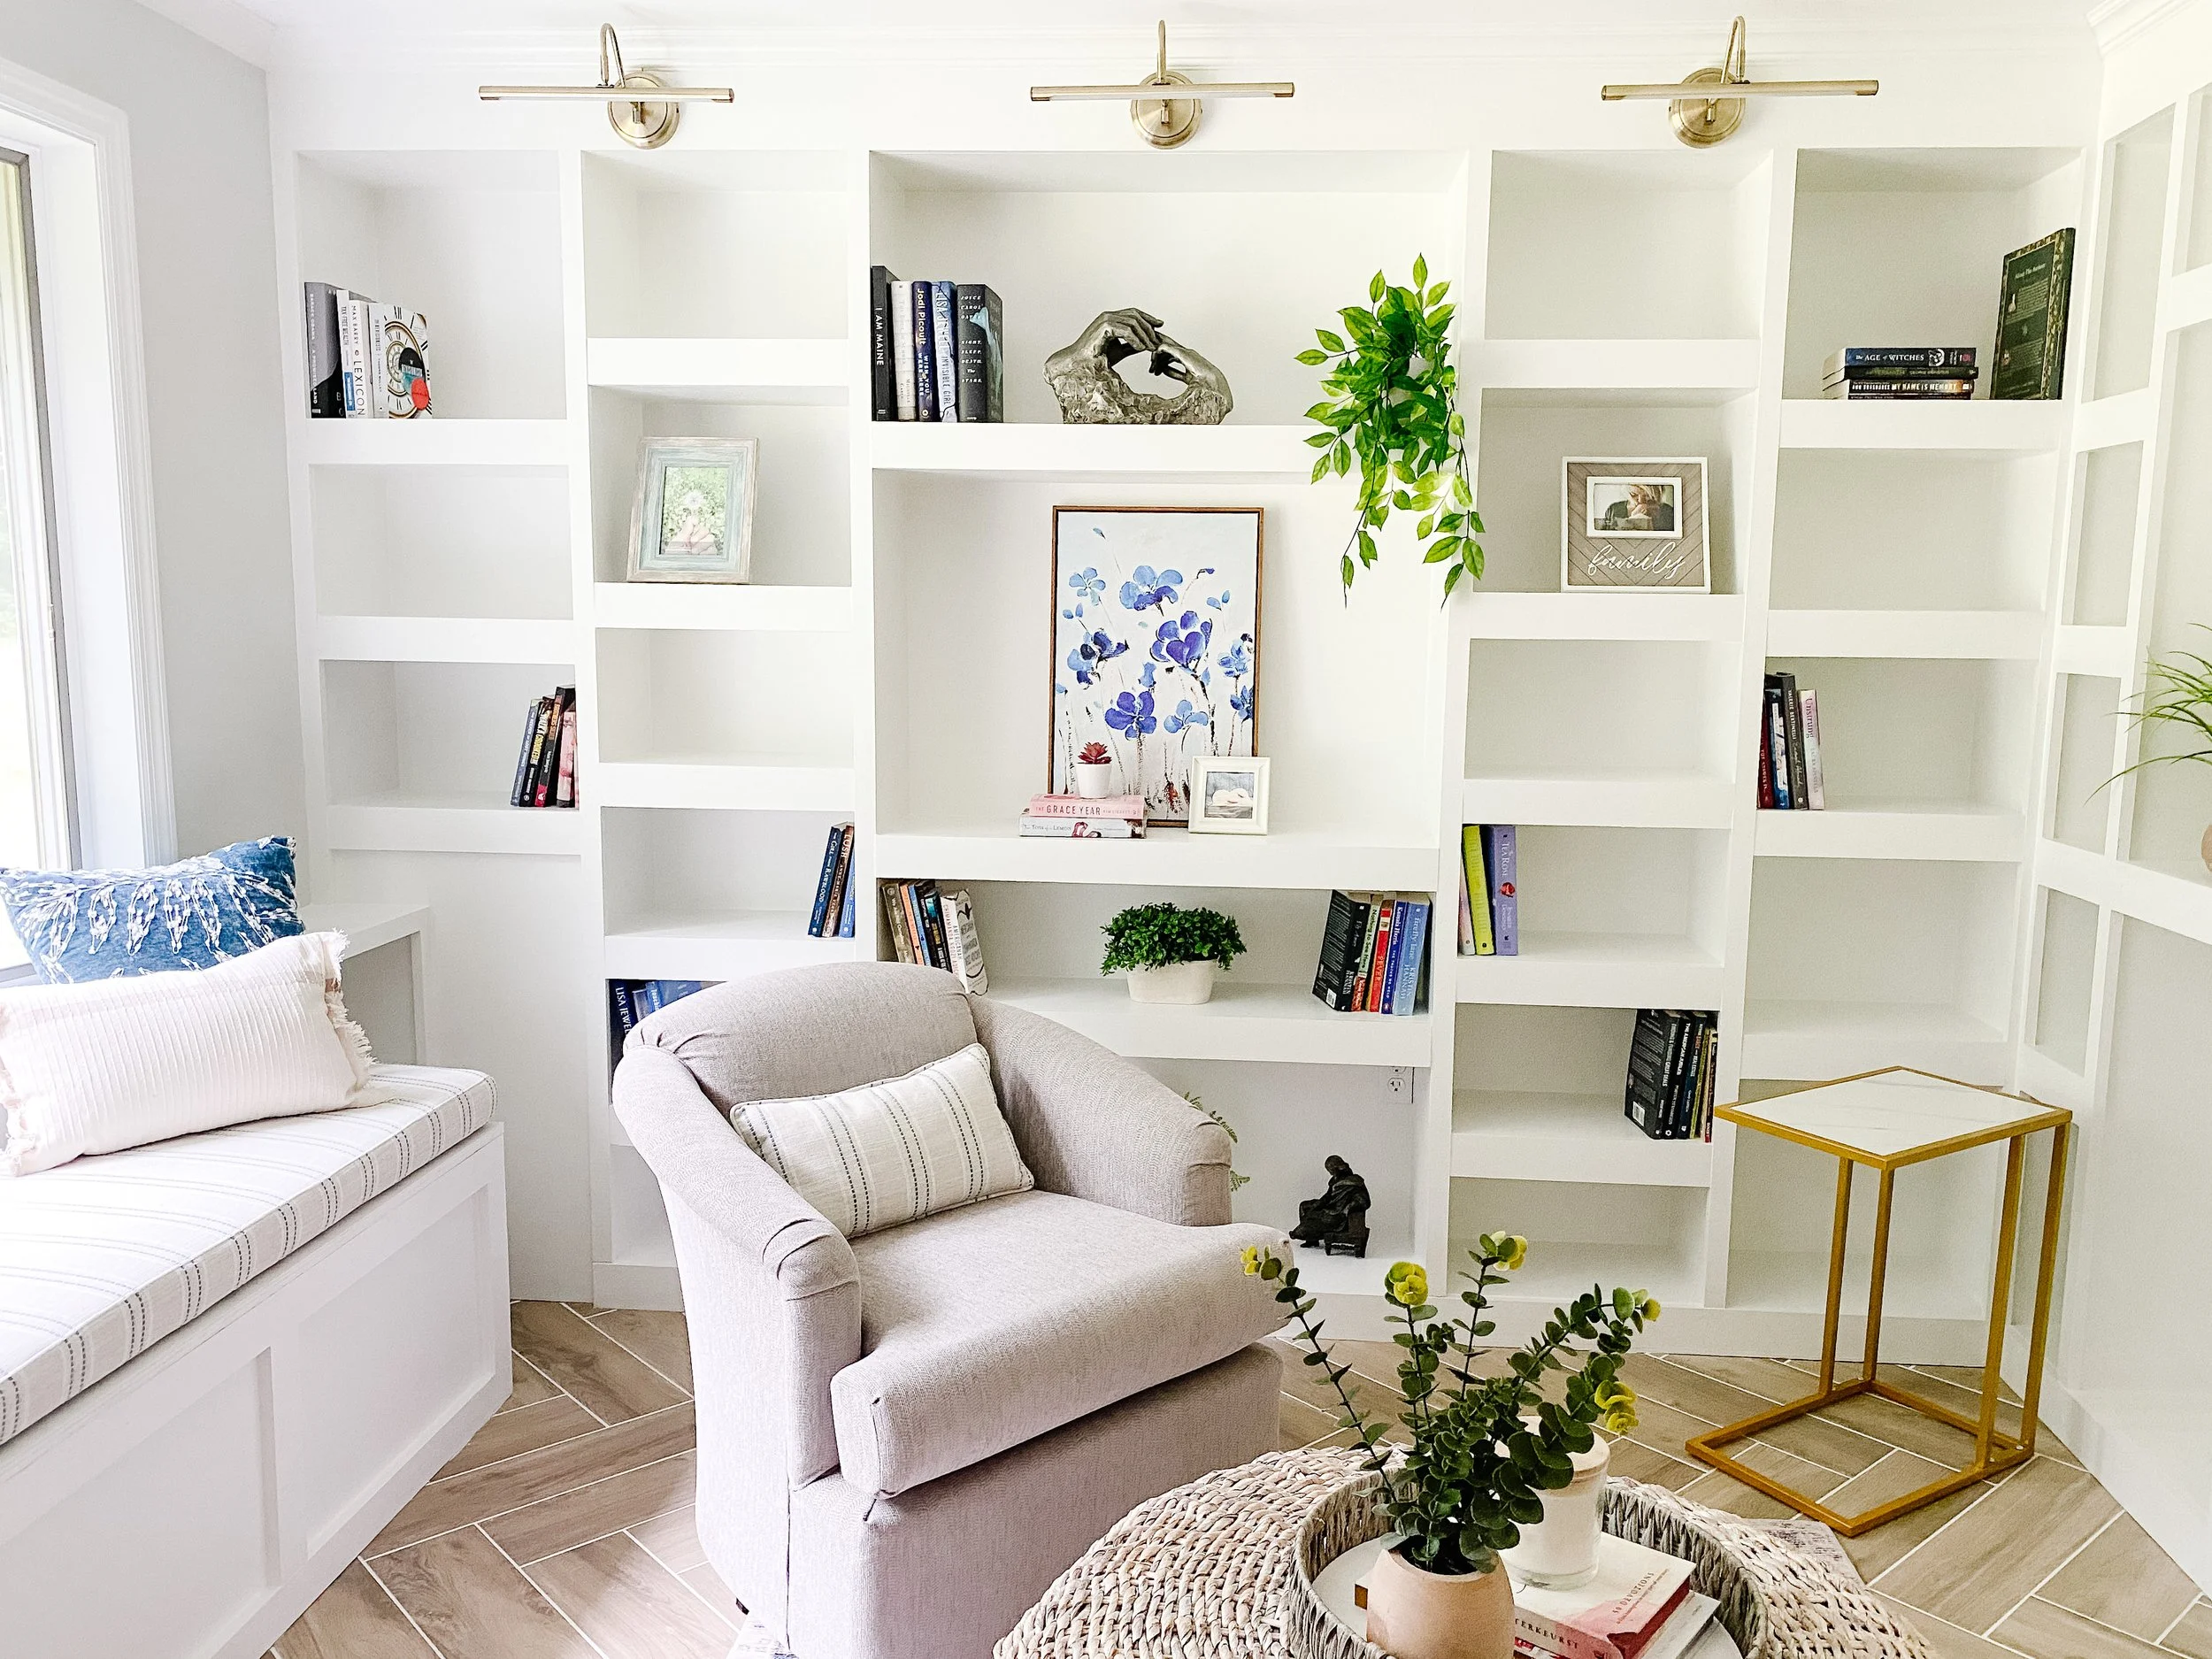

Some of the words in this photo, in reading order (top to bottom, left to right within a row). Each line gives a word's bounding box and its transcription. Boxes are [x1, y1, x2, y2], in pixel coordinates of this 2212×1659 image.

[935, 291, 949, 312] LISA
[875, 314, 884, 330] AM
[918, 311, 926, 345] Picoult
[876, 333, 885, 365] MAINE
[1888, 353, 1924, 362] WITCHES
[941, 355, 952, 388] INVISIBLE
[353, 360, 365, 416] LEXICON
[942, 390, 951, 406] GIRL
[1901, 382, 1920, 391] NAME
[1929, 382, 1957, 391] MEMORY
[1587, 541, 1686, 580] family
[1788, 711, 1797, 740] BERTINELLI
[1804, 697, 1816, 739] Unstrung
[1046, 805, 1076, 815] GRACE
[1079, 806, 1102, 816] YEAR
[828, 840, 838, 855] GIRL
[841, 833, 852, 858] LUSH
[1501, 841, 1510, 857] TEA
[1501, 857, 1510, 877] ROSE
[818, 867, 832, 902] RAWBLOOD
[1368, 909, 1378, 933] Nothing
[1394, 906, 1403, 928] Kamala
[1392, 927, 1401, 946] Harris
[1411, 917, 1421, 942] firefly
[1361, 954, 1370, 969] Here
[1408, 943, 1418, 960] lane
[1400, 964, 1410, 1000] HANNAH
[1406, 967, 1417, 997] KRISTIN
[615, 986, 627, 1007] LISA
[1620, 1571, 1655, 1607] DEVOTIONS
